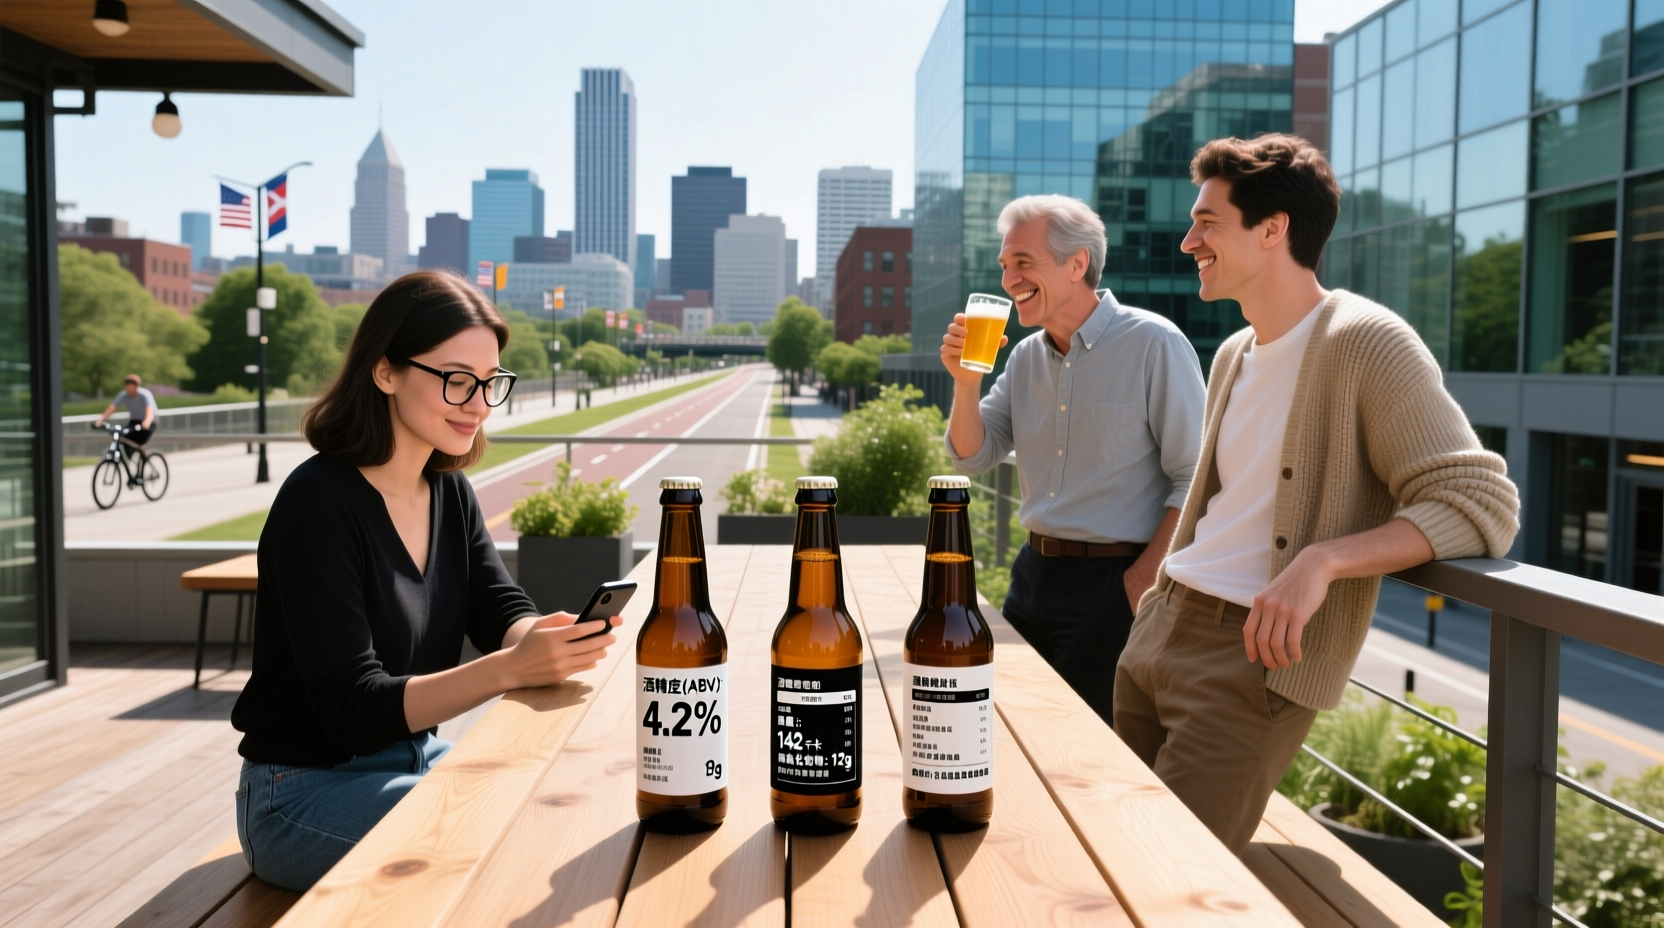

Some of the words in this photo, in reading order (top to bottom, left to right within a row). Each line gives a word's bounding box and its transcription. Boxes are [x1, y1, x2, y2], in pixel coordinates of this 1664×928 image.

[642, 699, 722, 737] 4.2%
[777, 730, 803, 750] 142
[831, 752, 853, 770] 12g
